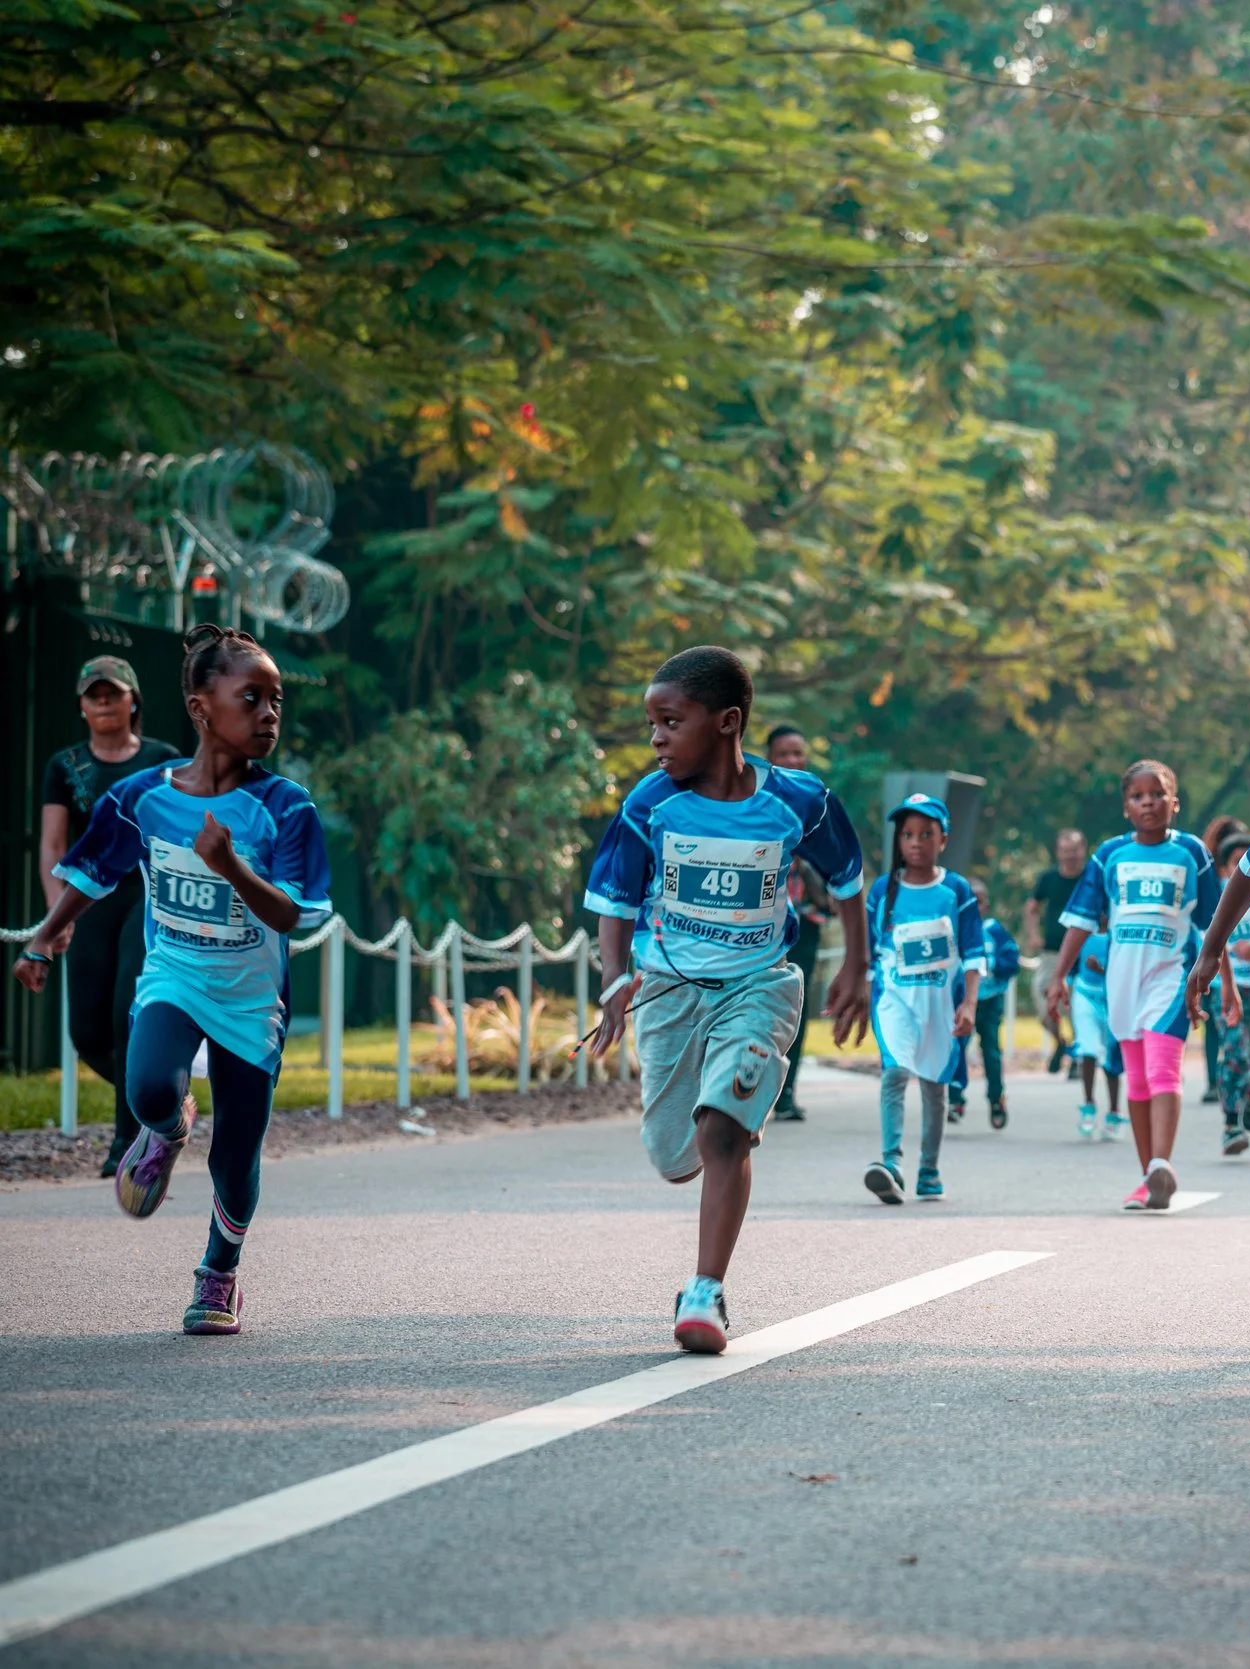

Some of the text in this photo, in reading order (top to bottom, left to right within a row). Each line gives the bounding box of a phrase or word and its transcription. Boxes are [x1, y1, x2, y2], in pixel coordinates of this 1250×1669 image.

[701, 869, 740, 897] 49
[1139, 879, 1163, 897] 80
[166, 876, 216, 911] 108
[733, 927, 770, 945] 2023
[920, 939, 933, 957] 3
